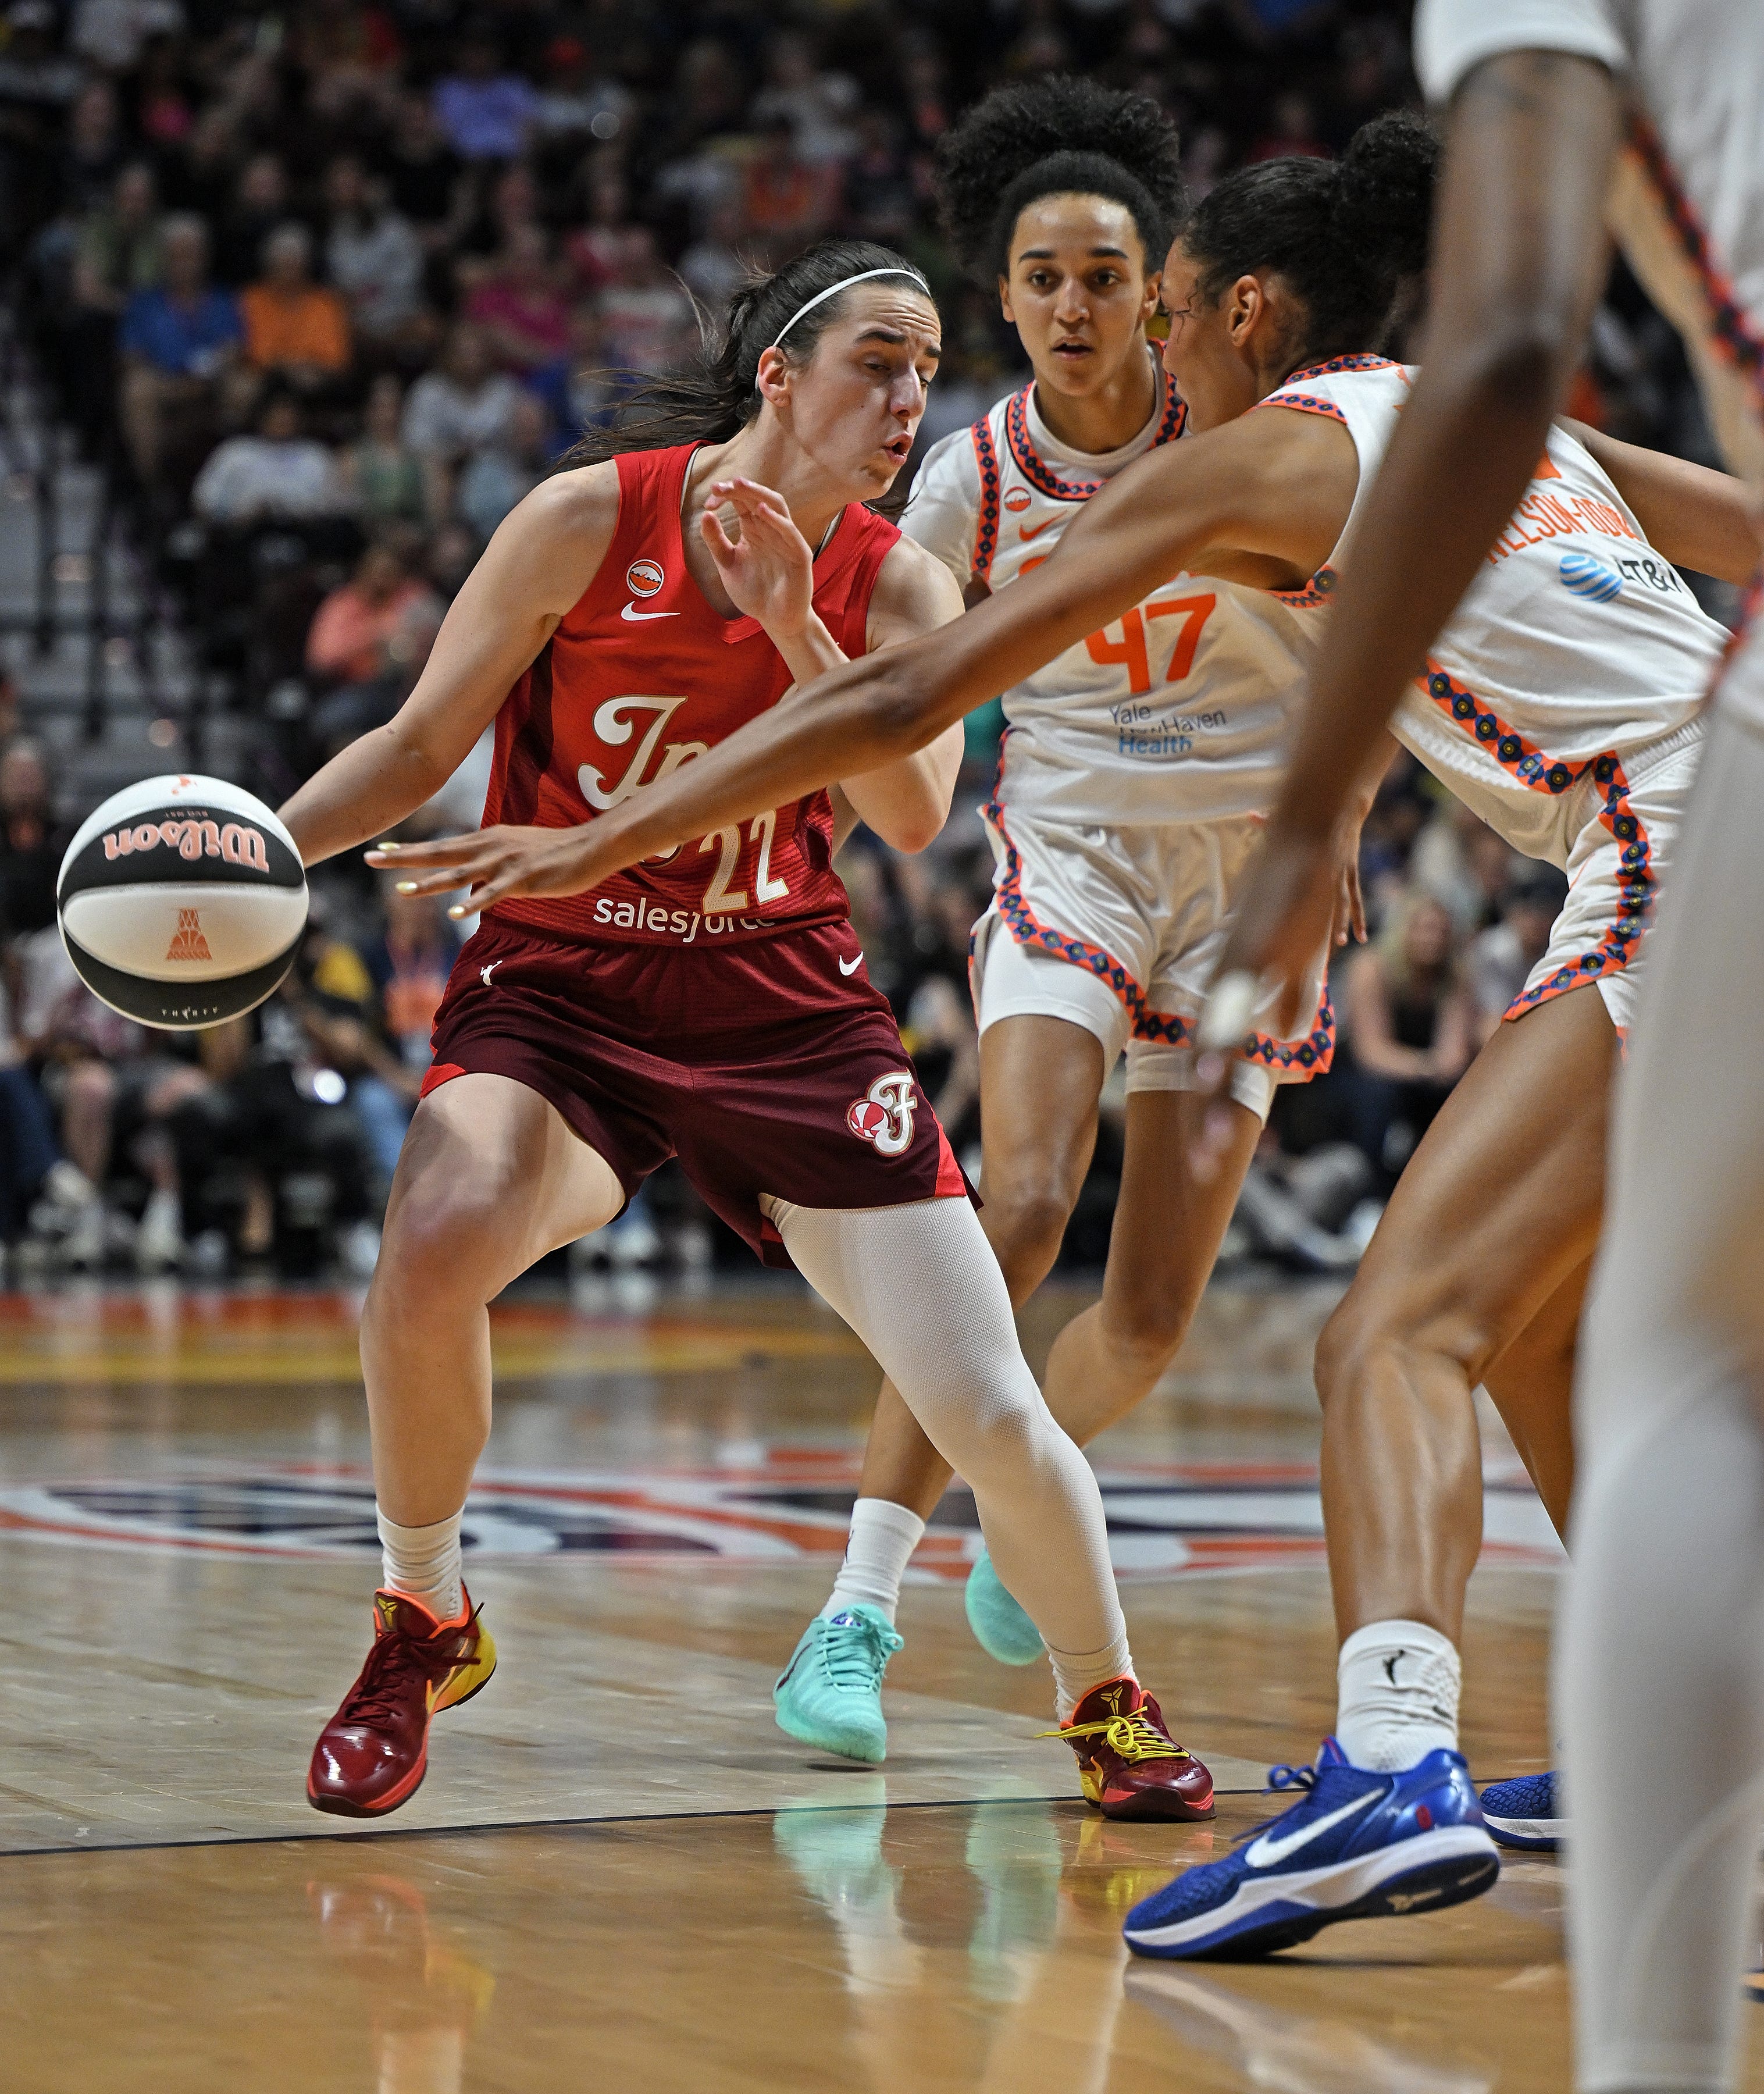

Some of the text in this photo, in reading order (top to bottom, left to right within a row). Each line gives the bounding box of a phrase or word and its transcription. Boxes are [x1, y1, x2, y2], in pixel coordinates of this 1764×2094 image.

[1085, 593, 1217, 694] 47
[1109, 703, 1151, 725] Yale
[1118, 735, 1193, 754] Health
[103, 820, 269, 872] Wilson
[698, 808, 790, 914] 22
